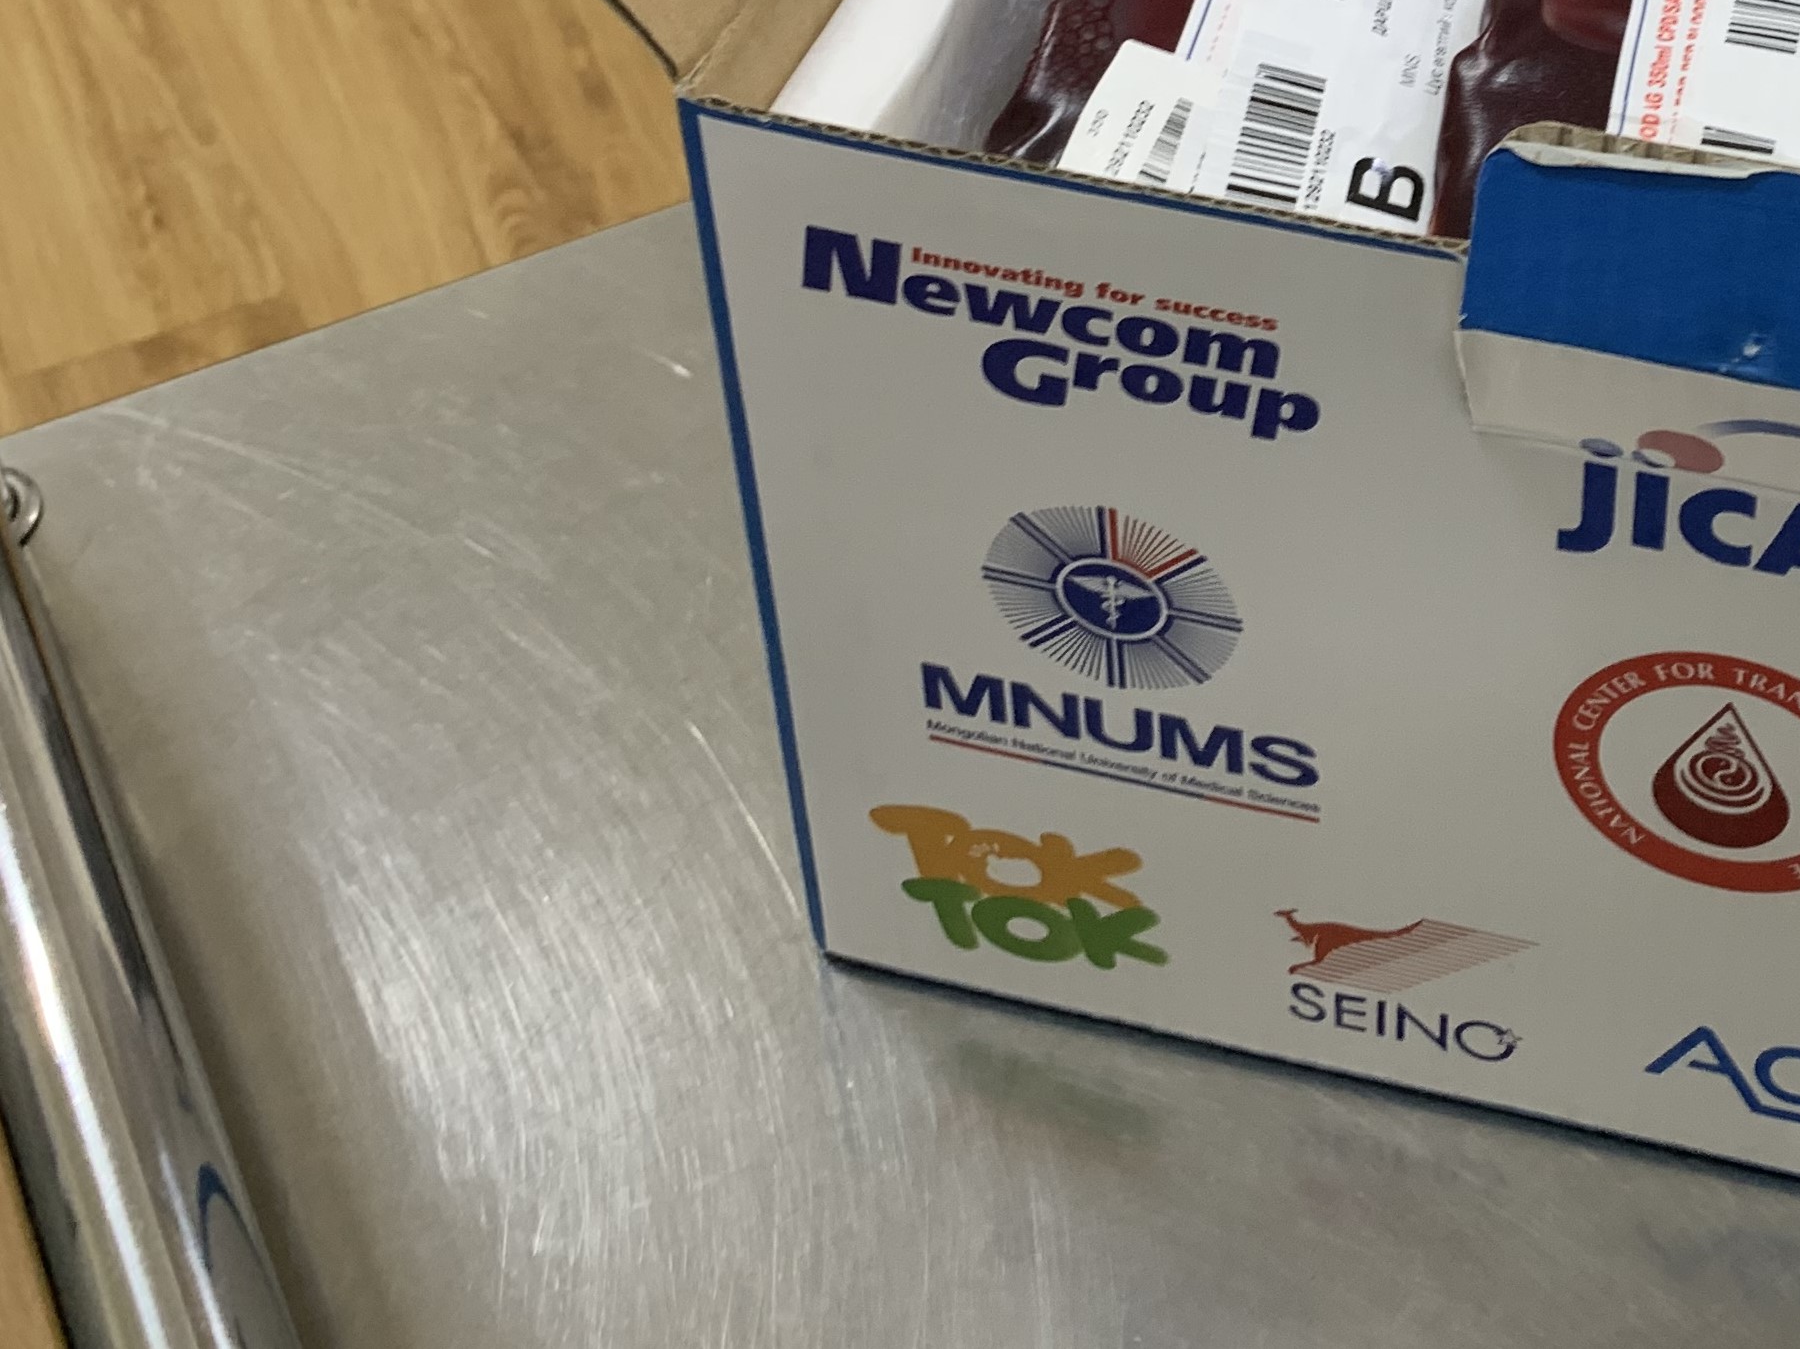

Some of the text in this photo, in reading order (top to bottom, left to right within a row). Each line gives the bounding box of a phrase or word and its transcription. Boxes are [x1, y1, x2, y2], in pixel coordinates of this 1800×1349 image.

[1346, 158, 1424, 220] B
[802, 225, 1280, 379] Newcom
[911, 247, 1279, 332] Innovating for success
[982, 339, 1321, 441] Group
[1572, 670, 1647, 732] CENTER
[1653, 661, 1715, 684] FOR
[920, 662, 1320, 788] MNUMS
[926, 718, 1009, 749] Mongolian
[1567, 741, 1646, 845] NATIONAL
[901, 876, 1169, 970] TOK
[1288, 982, 1520, 1062] SEINO
